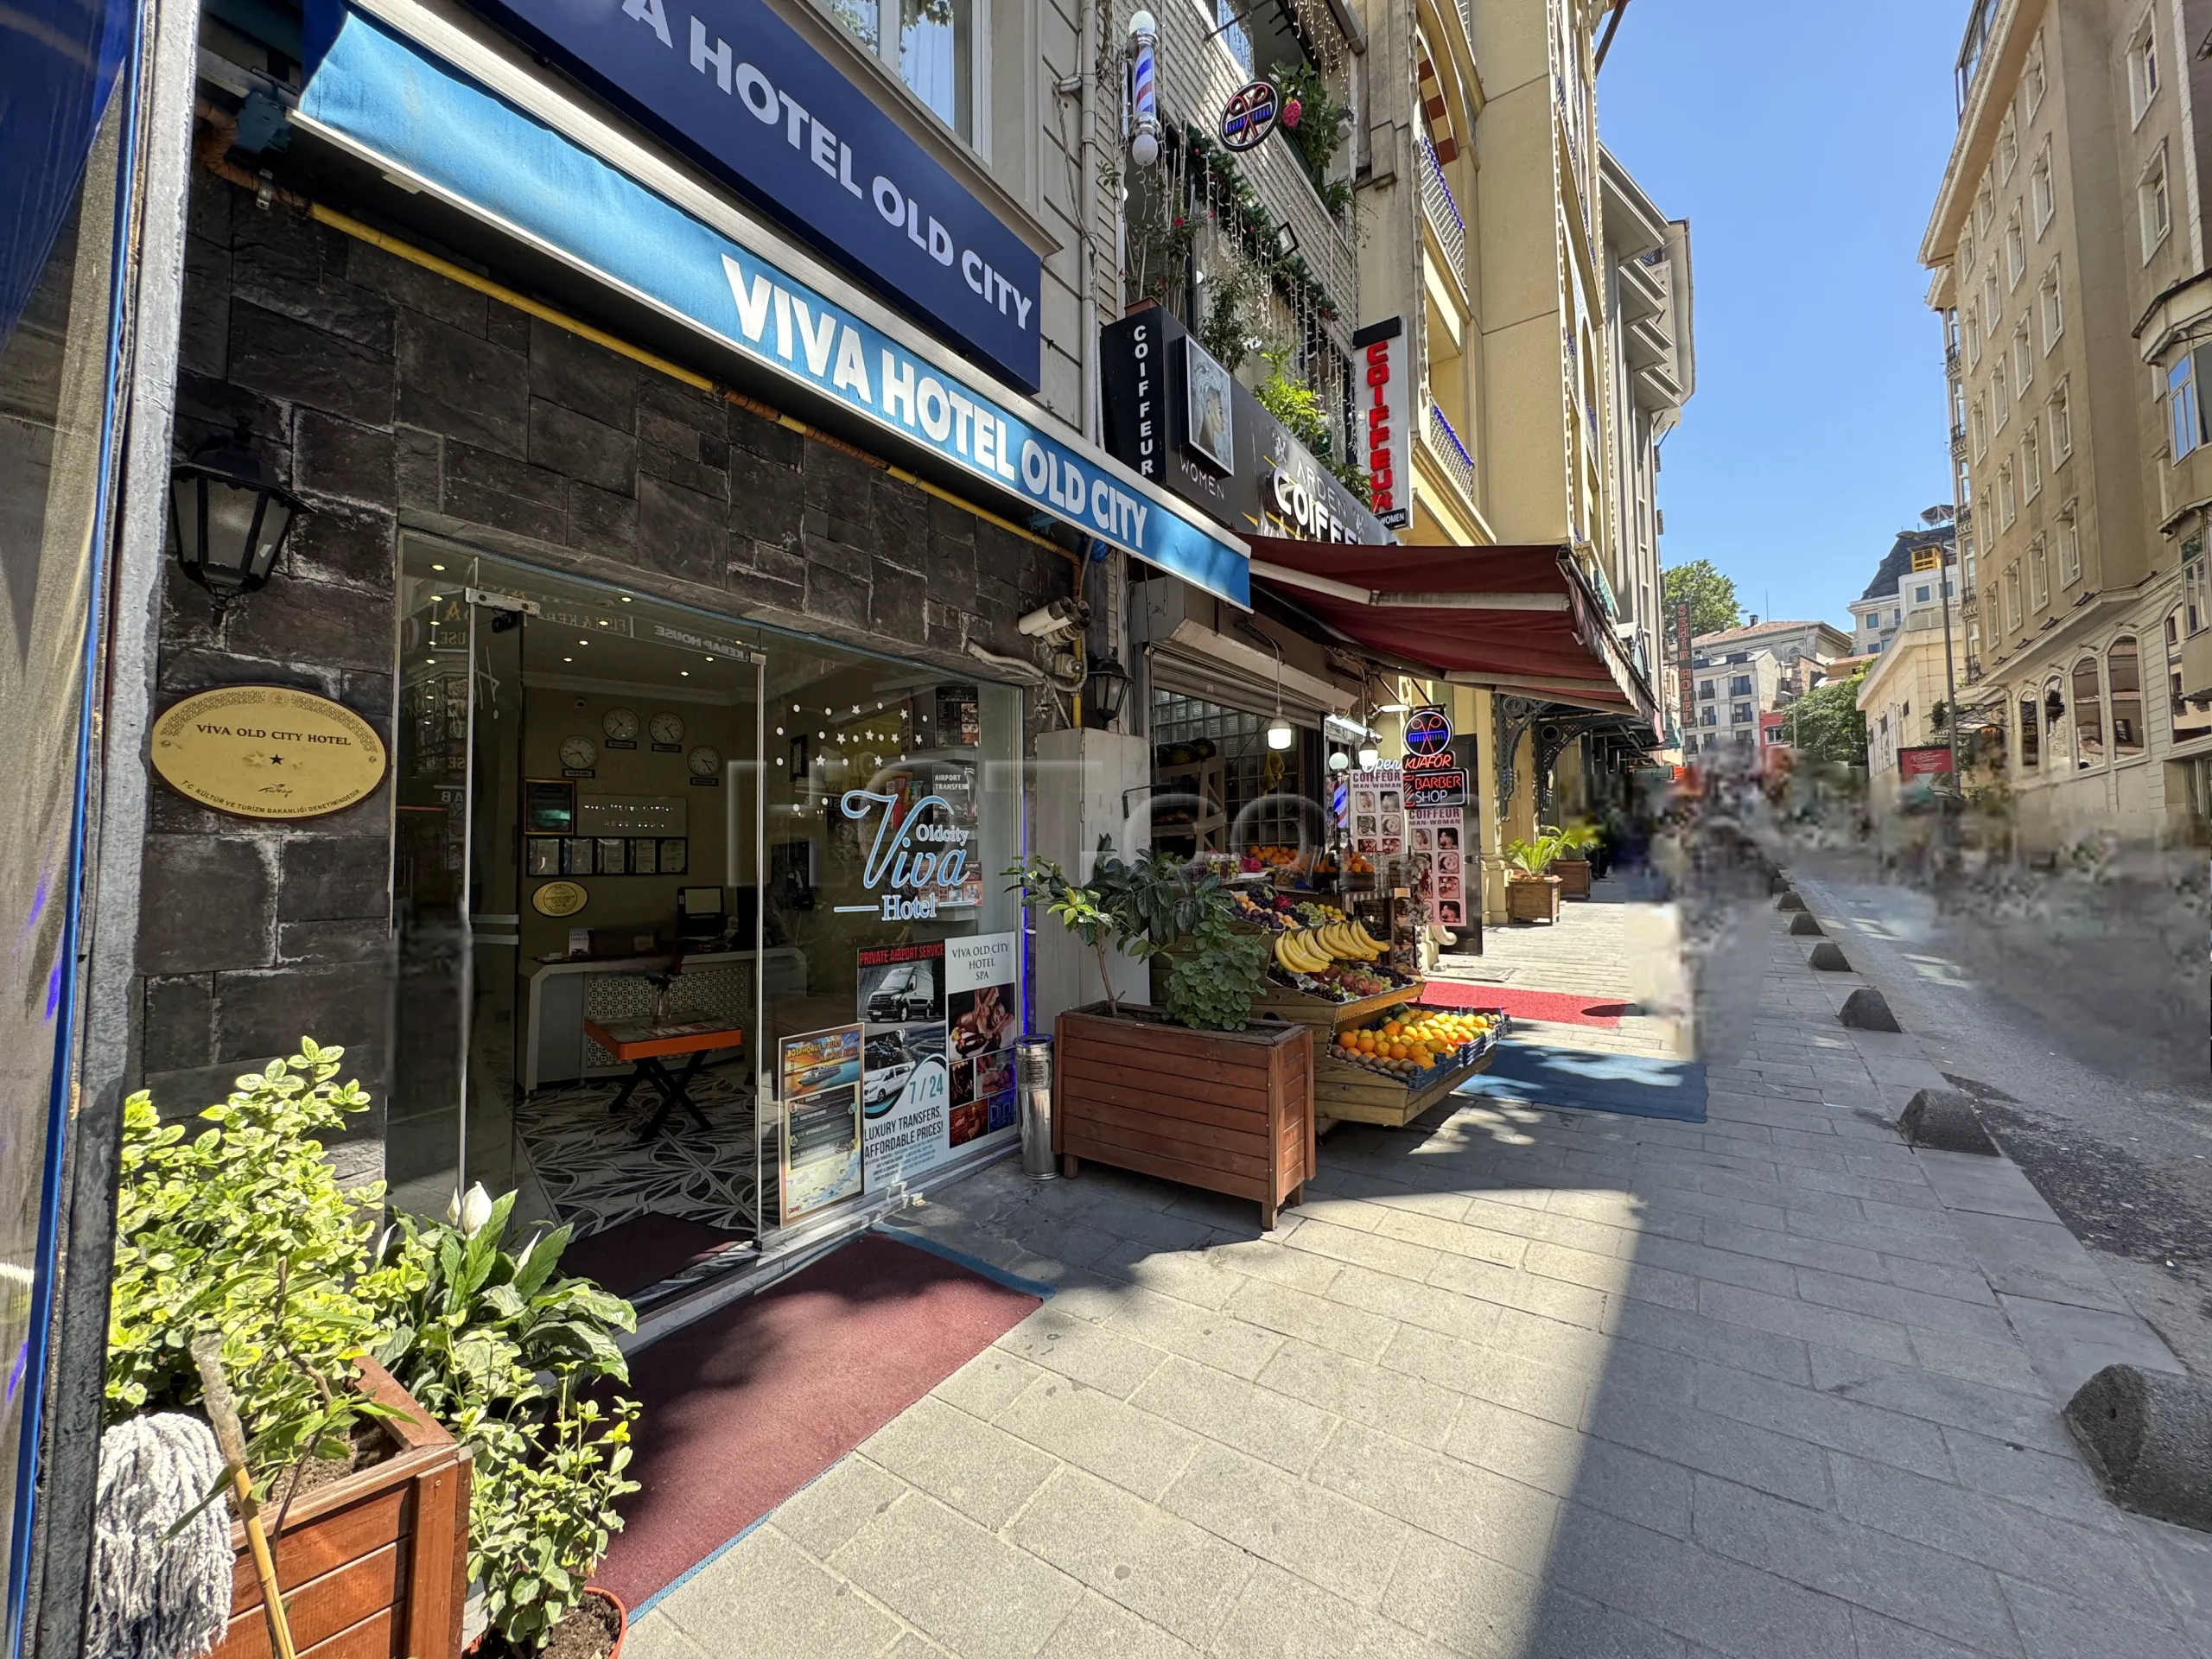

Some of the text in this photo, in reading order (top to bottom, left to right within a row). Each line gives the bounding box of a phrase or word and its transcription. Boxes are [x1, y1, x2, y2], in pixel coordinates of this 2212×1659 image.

[691, 14, 862, 199] HOTEL
[872, 175, 953, 266] OLD
[961, 250, 1032, 329] CITY
[721, 254, 1148, 549] VIVA HOTEL OLD CITY
[1133, 325, 1154, 476] COIFFEUR
[1366, 340, 1394, 514] COIFFEUR
[1179, 454, 1224, 500] WOMEN
[1297, 458, 1348, 518] ARDEN
[1274, 467, 1364, 546] COIFF
[1380, 512, 1405, 525] WOMEN
[1680, 668, 1693, 723] HOTEL
[237, 728, 266, 739] OLD
[271, 731, 303, 741] CITY
[308, 734, 351, 746] HOTEL
[1352, 772, 1401, 783] COIFFEUR
[1415, 775, 1462, 790] BARBER
[195, 787, 224, 804] KÜLTÜR
[224, 799, 237, 809] VE
[237, 803, 266, 814] TURİZM
[267, 806, 308, 815] BAKANLIĞI
[1414, 789, 1448, 804] SHOP
[1408, 808, 1460, 819] COIFFEUR
[841, 790, 971, 890] Viva
[916, 823, 969, 847] Oldcity
[881, 893, 937, 921] Hotel
[860, 943, 944, 966] PRIVATE AIRPORT SERVICE
[969, 957, 995, 970] HOTEL
[972, 944, 991, 956] OLD
[976, 971, 989, 981] SPA
[787, 1043, 822, 1058] BOSPHORUS
[865, 1105, 942, 1142] LUXURY TRANSFERS,
[865, 1120, 944, 1160] AFFORDABLE PRICES!
